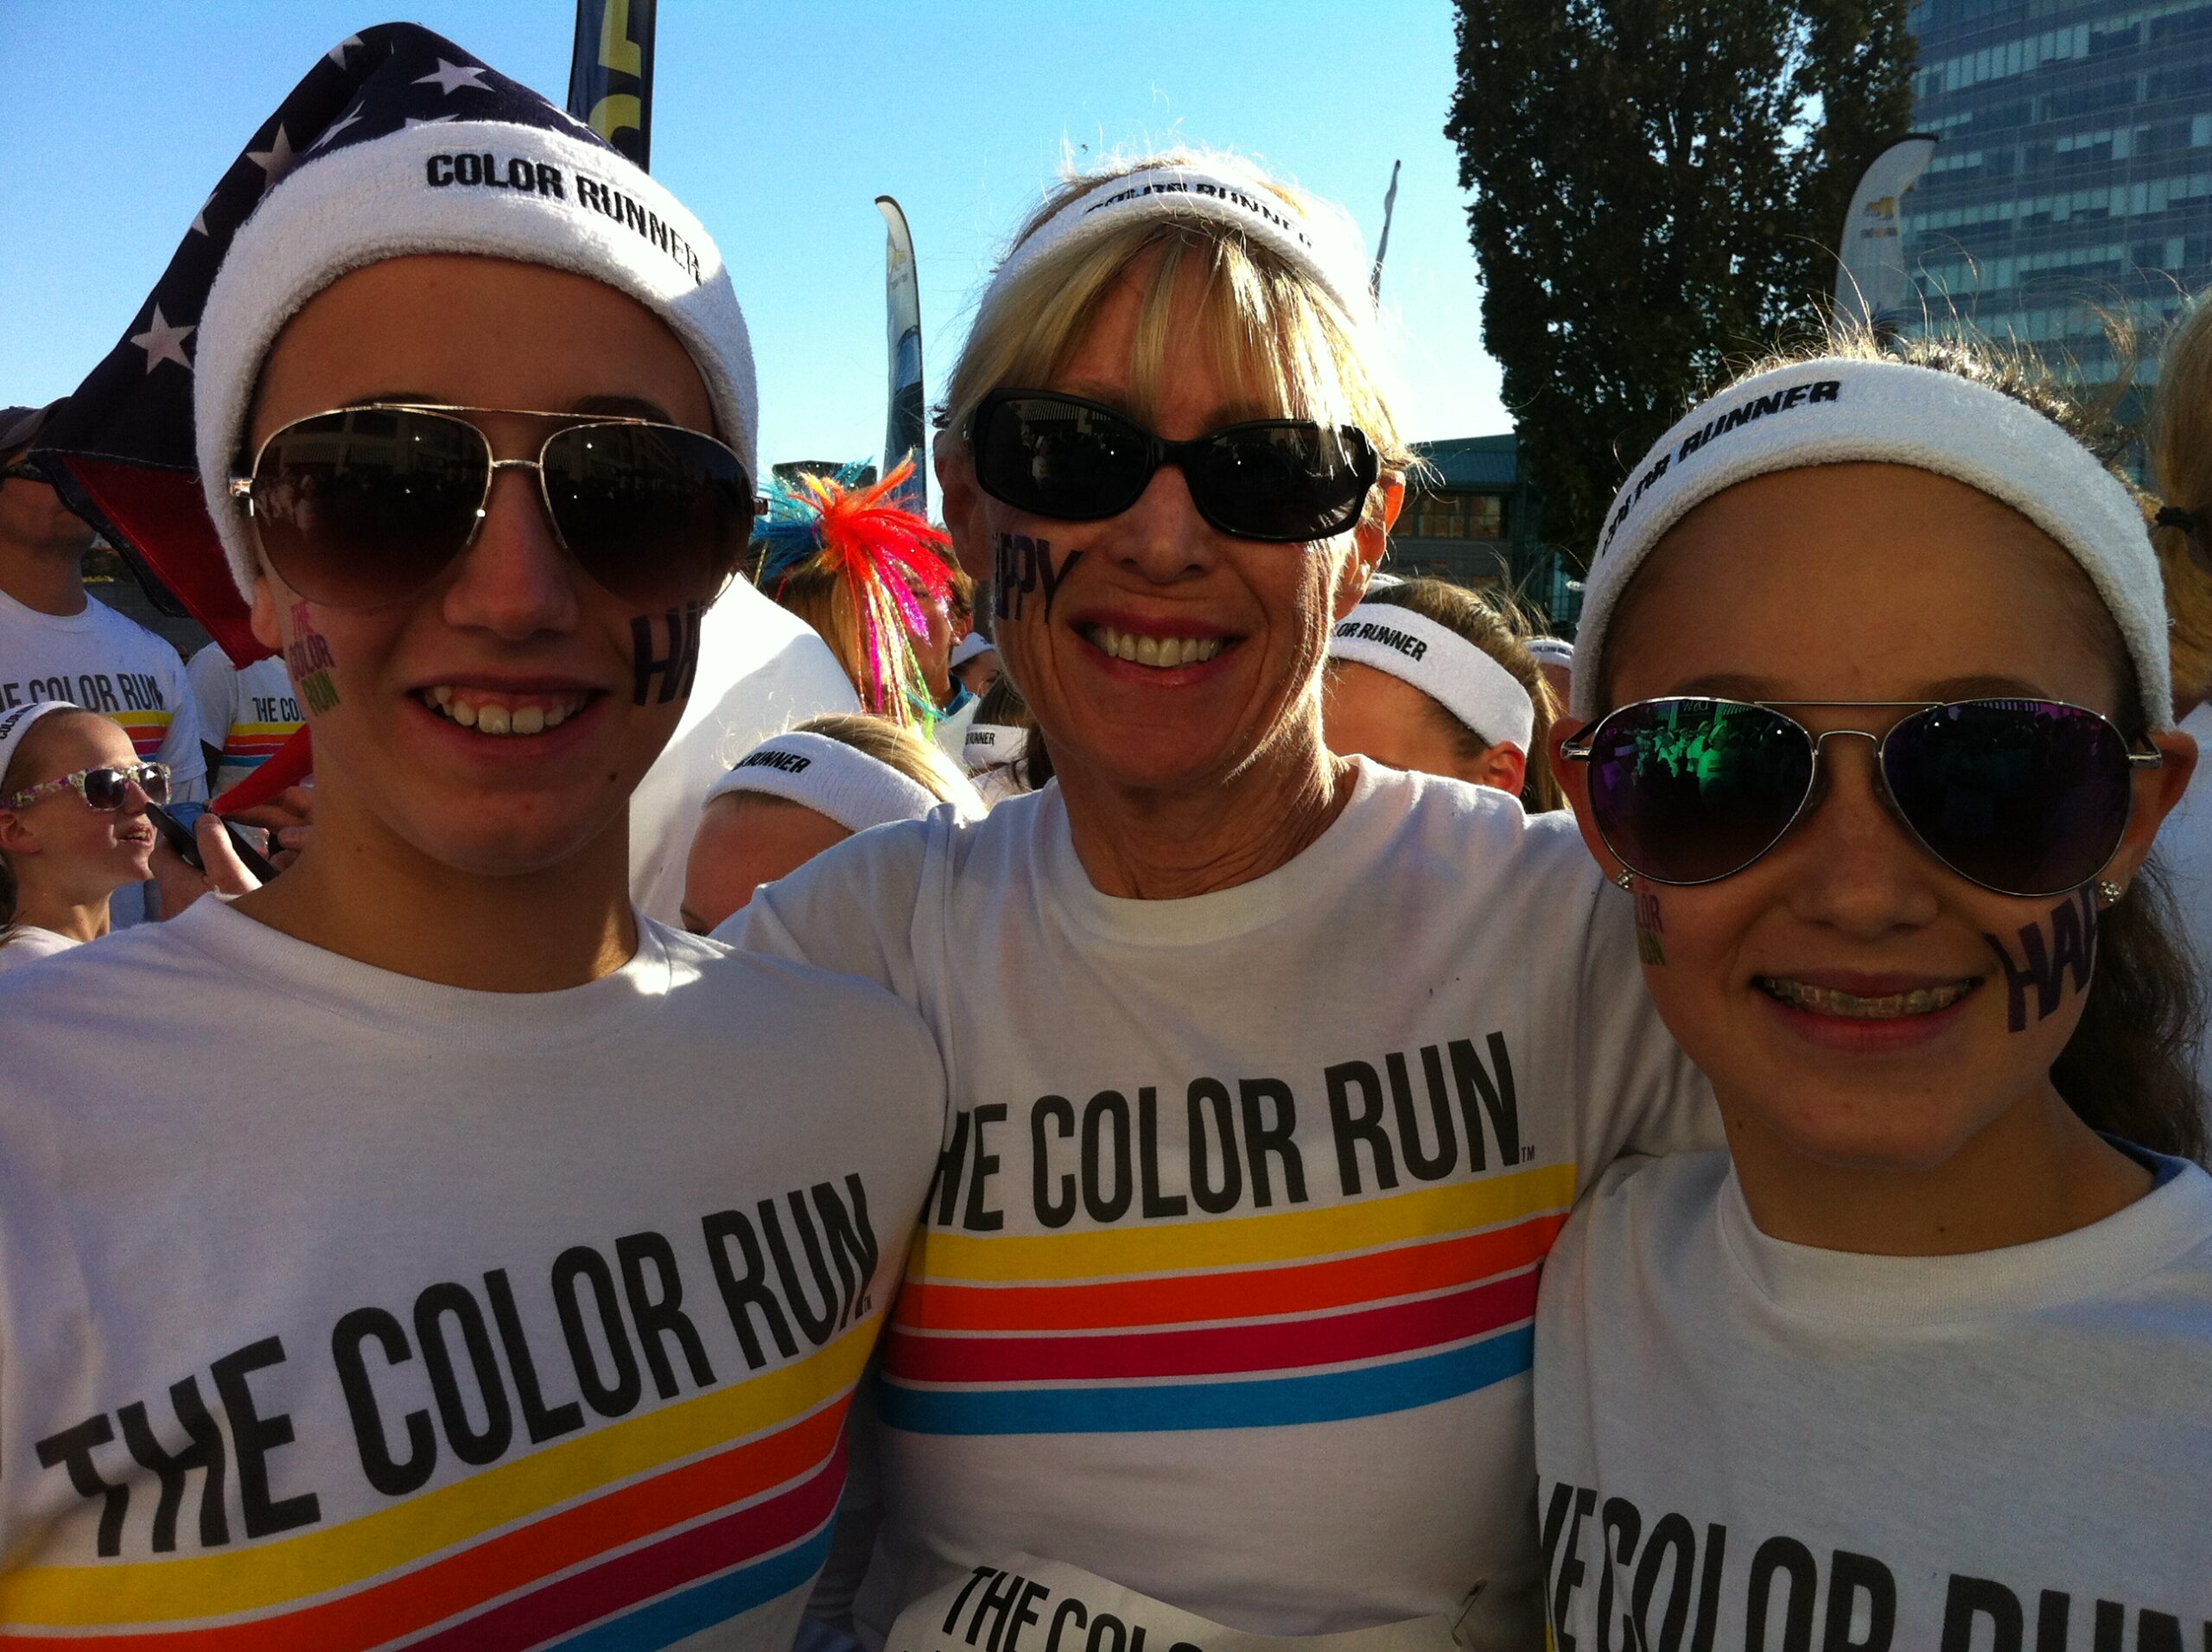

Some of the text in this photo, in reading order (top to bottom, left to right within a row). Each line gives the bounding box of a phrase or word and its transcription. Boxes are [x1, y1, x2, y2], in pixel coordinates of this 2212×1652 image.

[427, 153, 702, 286] COLOR RUNNER
[1678, 380, 1840, 463] RUNNER
[995, 532, 1084, 623] PPY
[1357, 622, 1427, 662] RUNNER
[29, 675, 120, 714] COLOR
[117, 673, 165, 711] RUN
[252, 697, 278, 722] THE
[920, 1103, 1007, 1231] HE
[1031, 1077, 1308, 1228] COLOR
[1324, 1031, 1520, 1196] RUN
[36, 1335, 321, 1559] THE
[332, 1231, 717, 1496] COLOR
[702, 1172, 880, 1370] RUN
[942, 1566, 1050, 1652] THE
